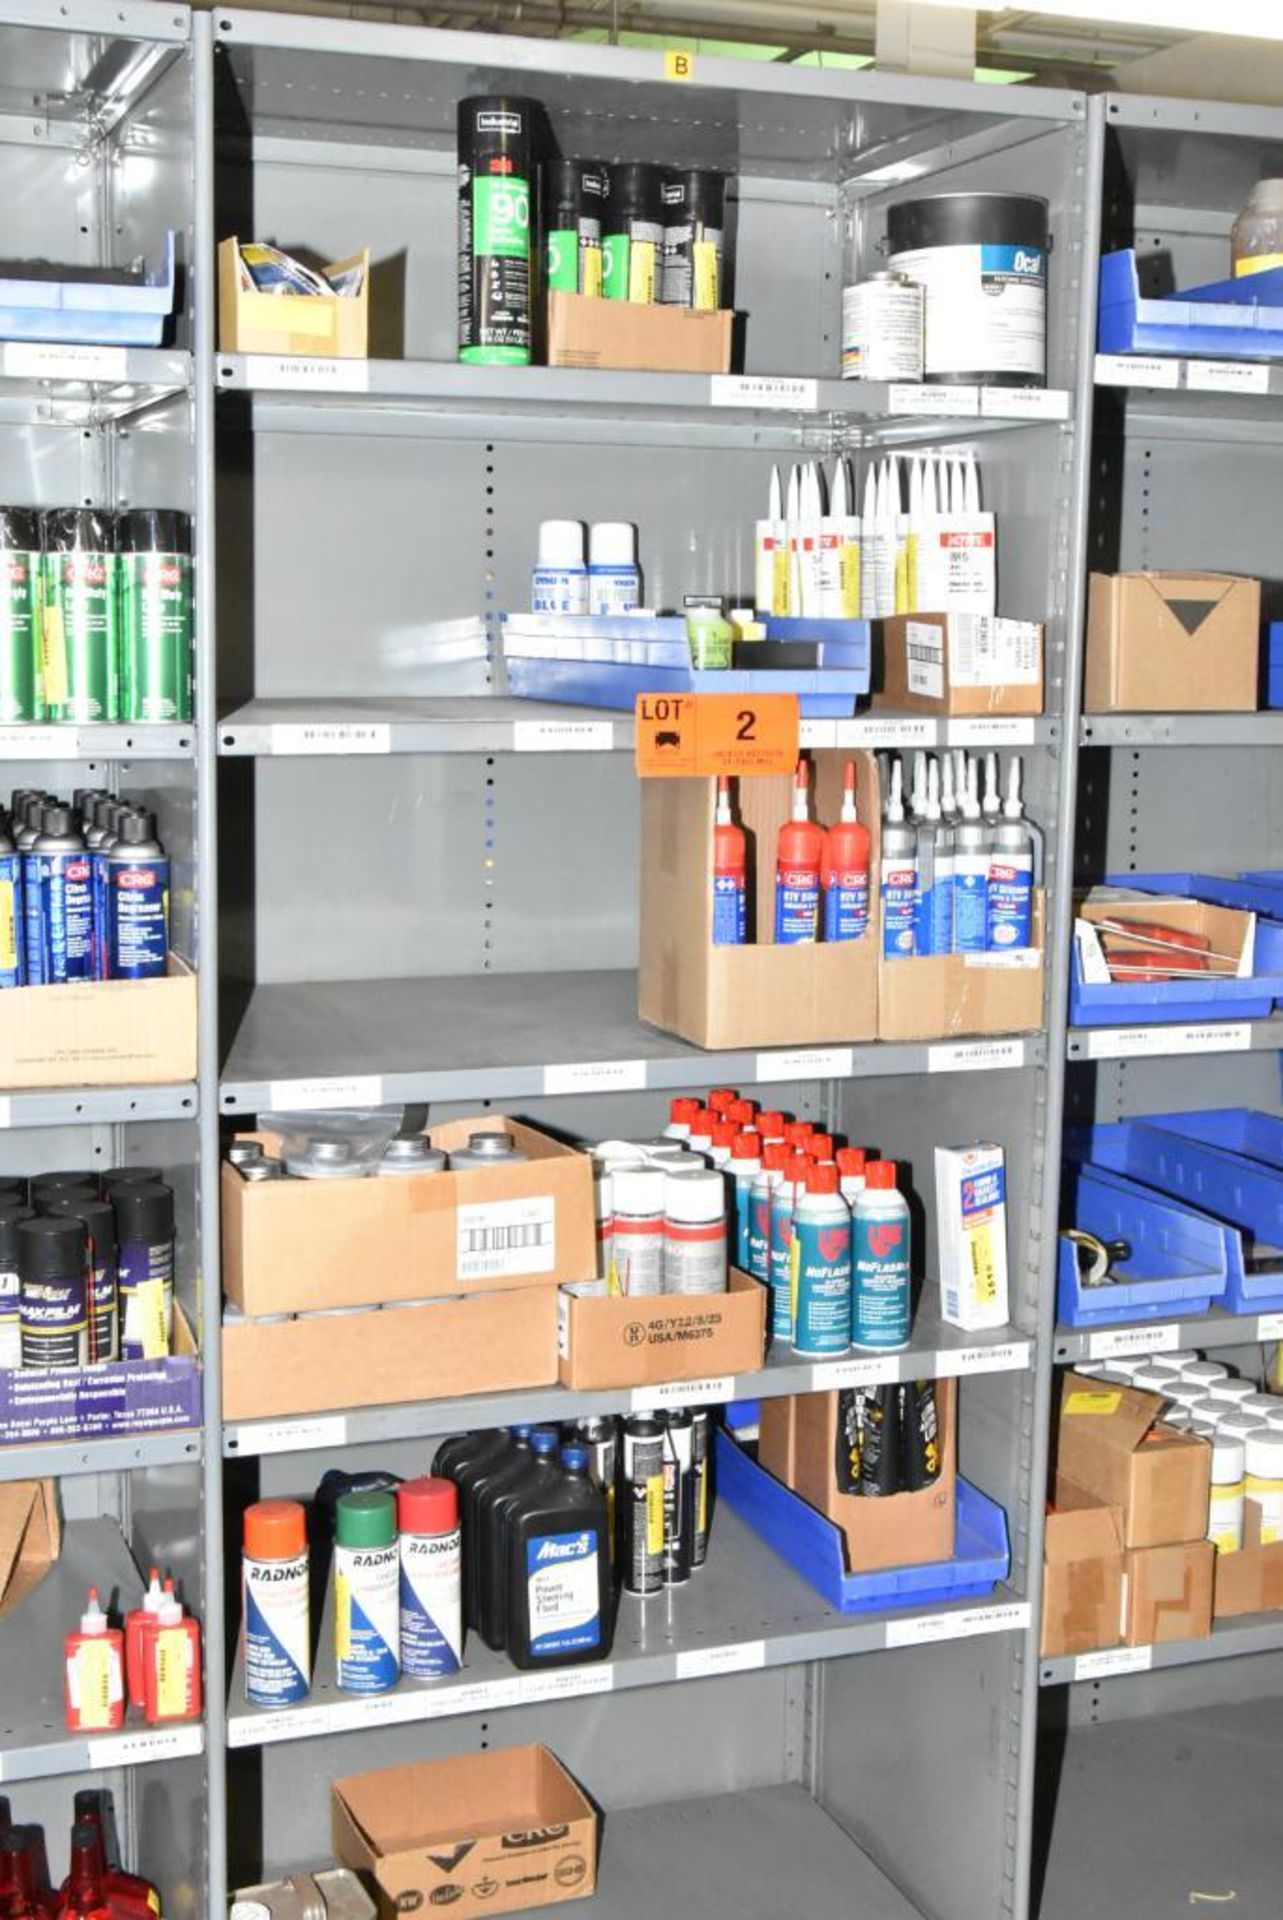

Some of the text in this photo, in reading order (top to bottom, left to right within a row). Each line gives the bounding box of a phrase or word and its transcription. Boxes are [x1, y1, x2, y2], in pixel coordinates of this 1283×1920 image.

[675, 56, 689, 75] B
[491, 193, 529, 229] 90
[1014, 251, 1041, 273] Ocal
[642, 699, 684, 720] LOT
[736, 710, 757, 741] 2
[119, 872, 156, 887] CRC
[537, 1538, 588, 1560] Mac's
